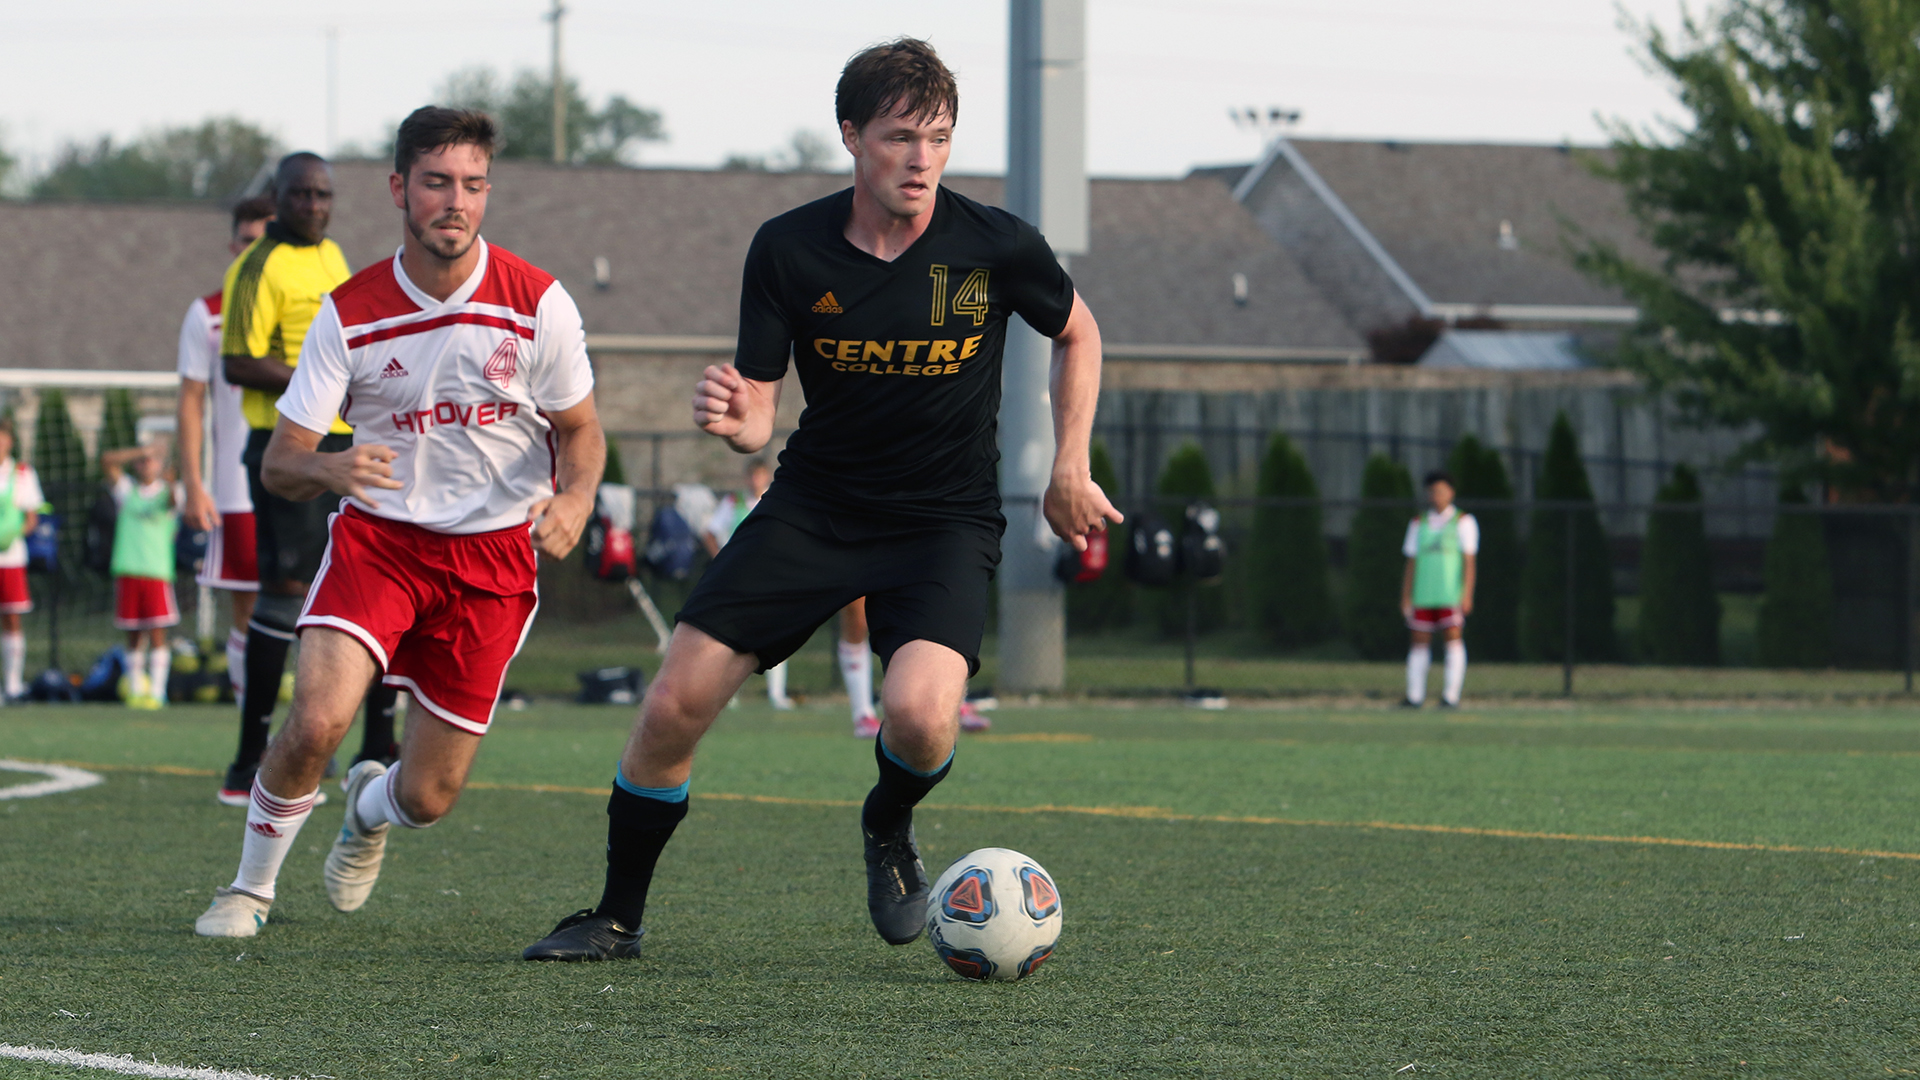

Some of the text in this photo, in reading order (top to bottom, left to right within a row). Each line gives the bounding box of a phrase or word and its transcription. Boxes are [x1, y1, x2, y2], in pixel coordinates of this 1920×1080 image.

[929, 264, 990, 326] 14
[811, 305, 844, 314] adidas
[813, 334, 983, 362] CENTRE
[483, 337, 518, 388] 4
[831, 362, 961, 376] COLLEGE
